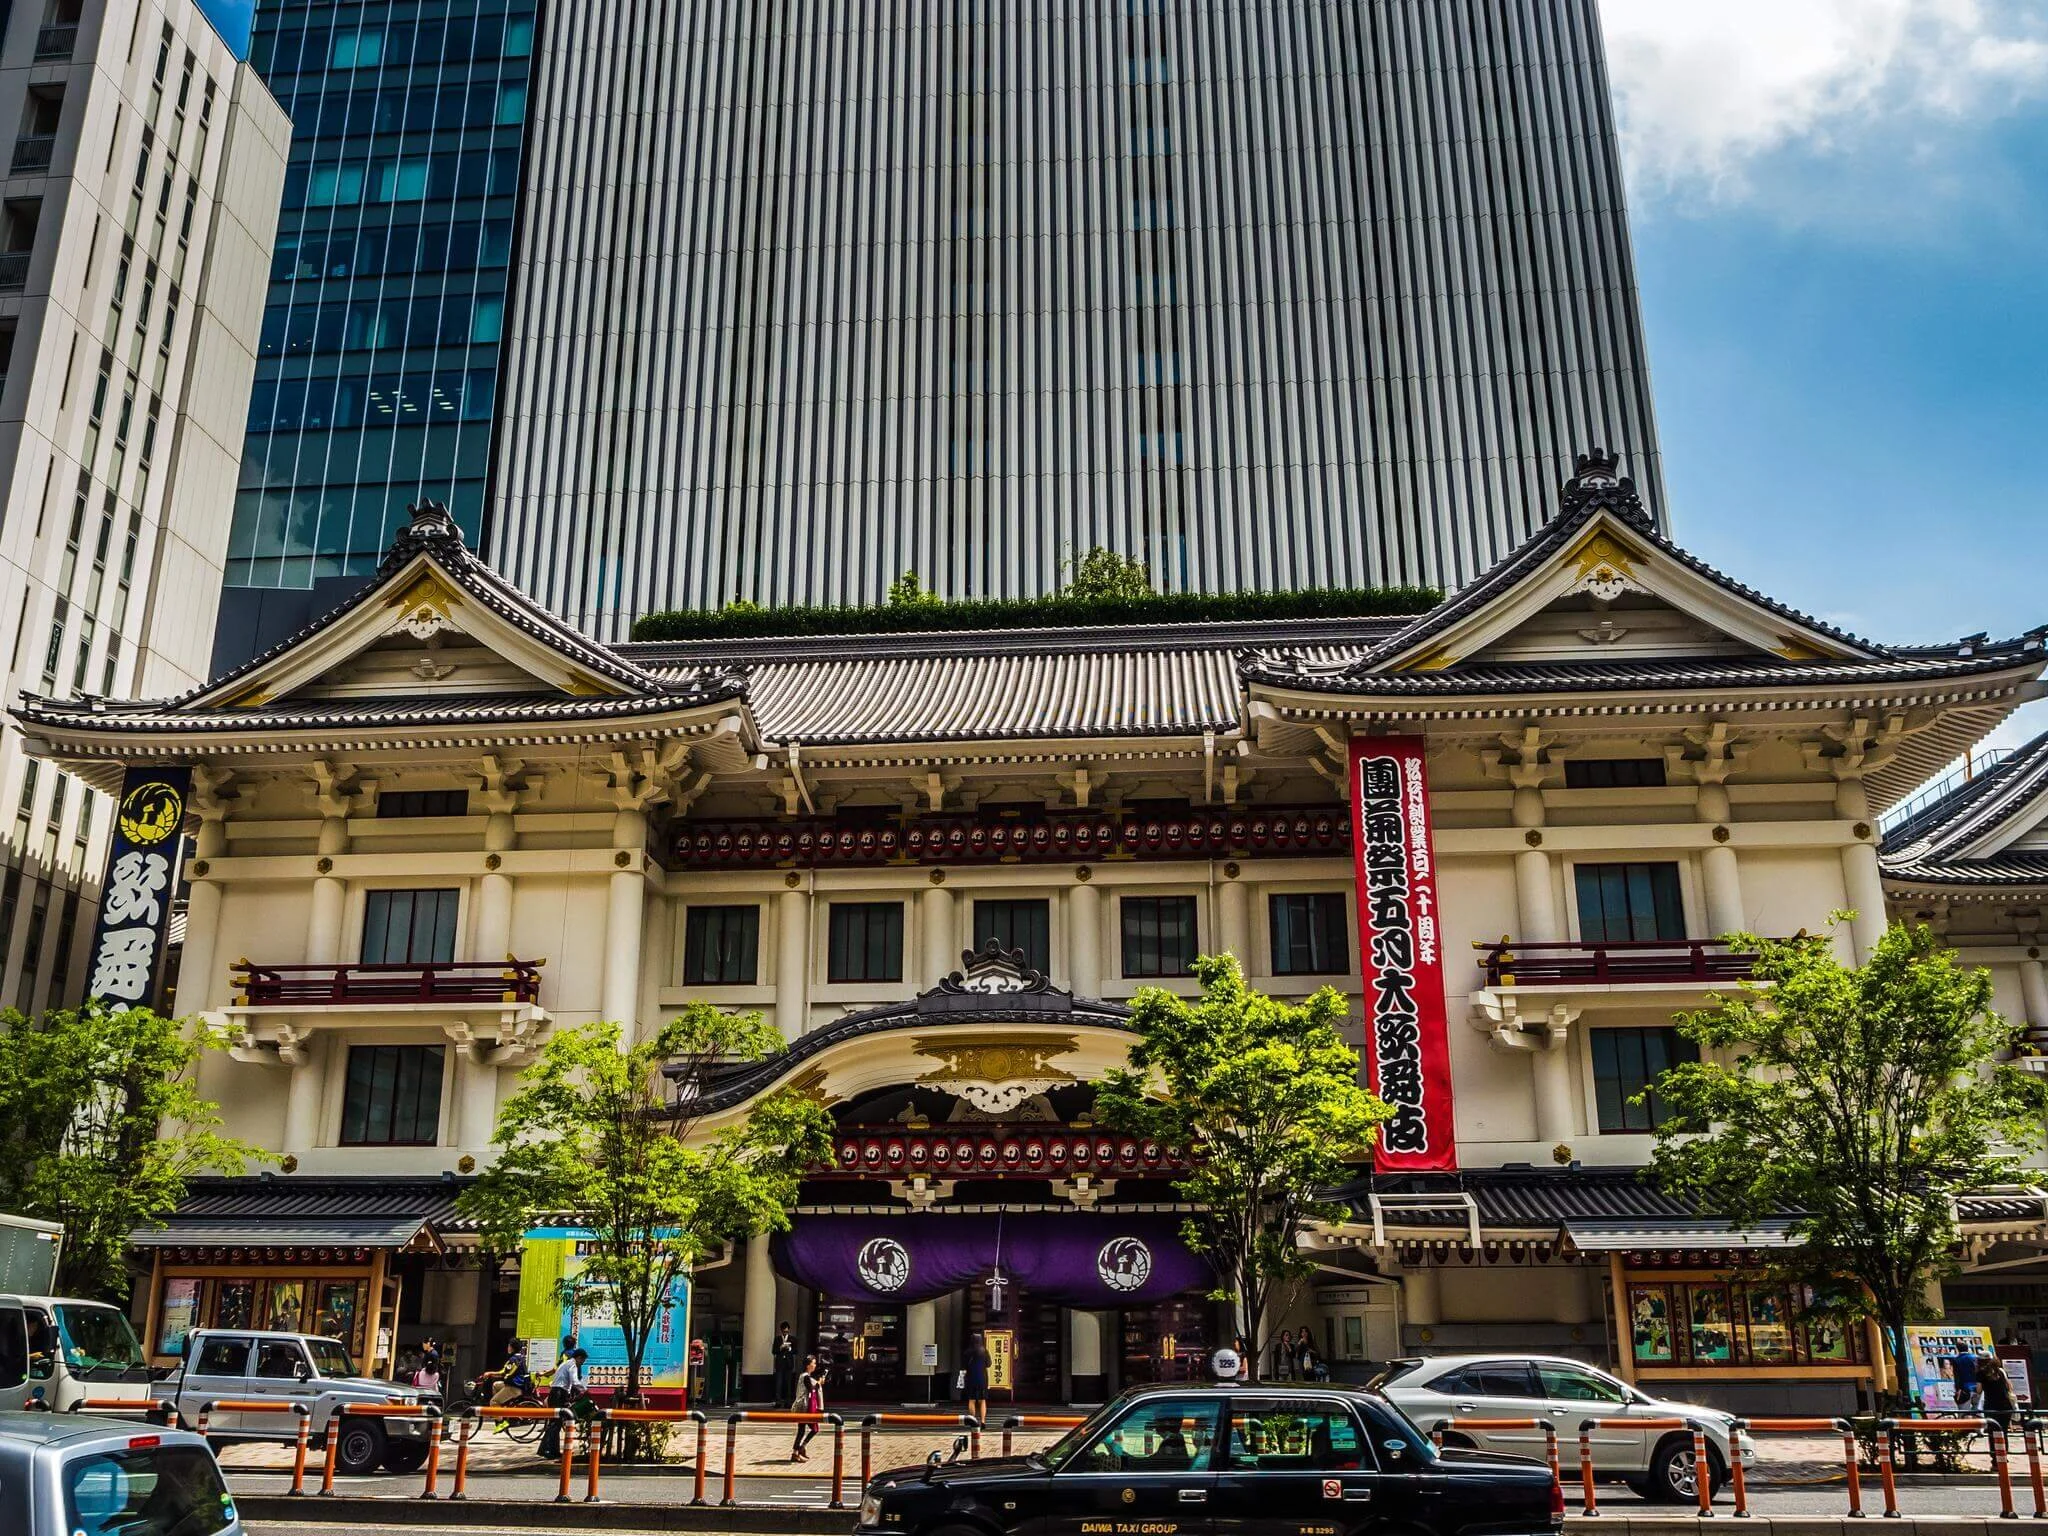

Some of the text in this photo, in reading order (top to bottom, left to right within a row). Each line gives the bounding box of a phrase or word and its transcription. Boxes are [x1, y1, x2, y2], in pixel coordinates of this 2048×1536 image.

[1219, 1360, 1236, 1368] 3295
[1081, 1523, 1177, 1533] DAIWA TAXI GROUP
